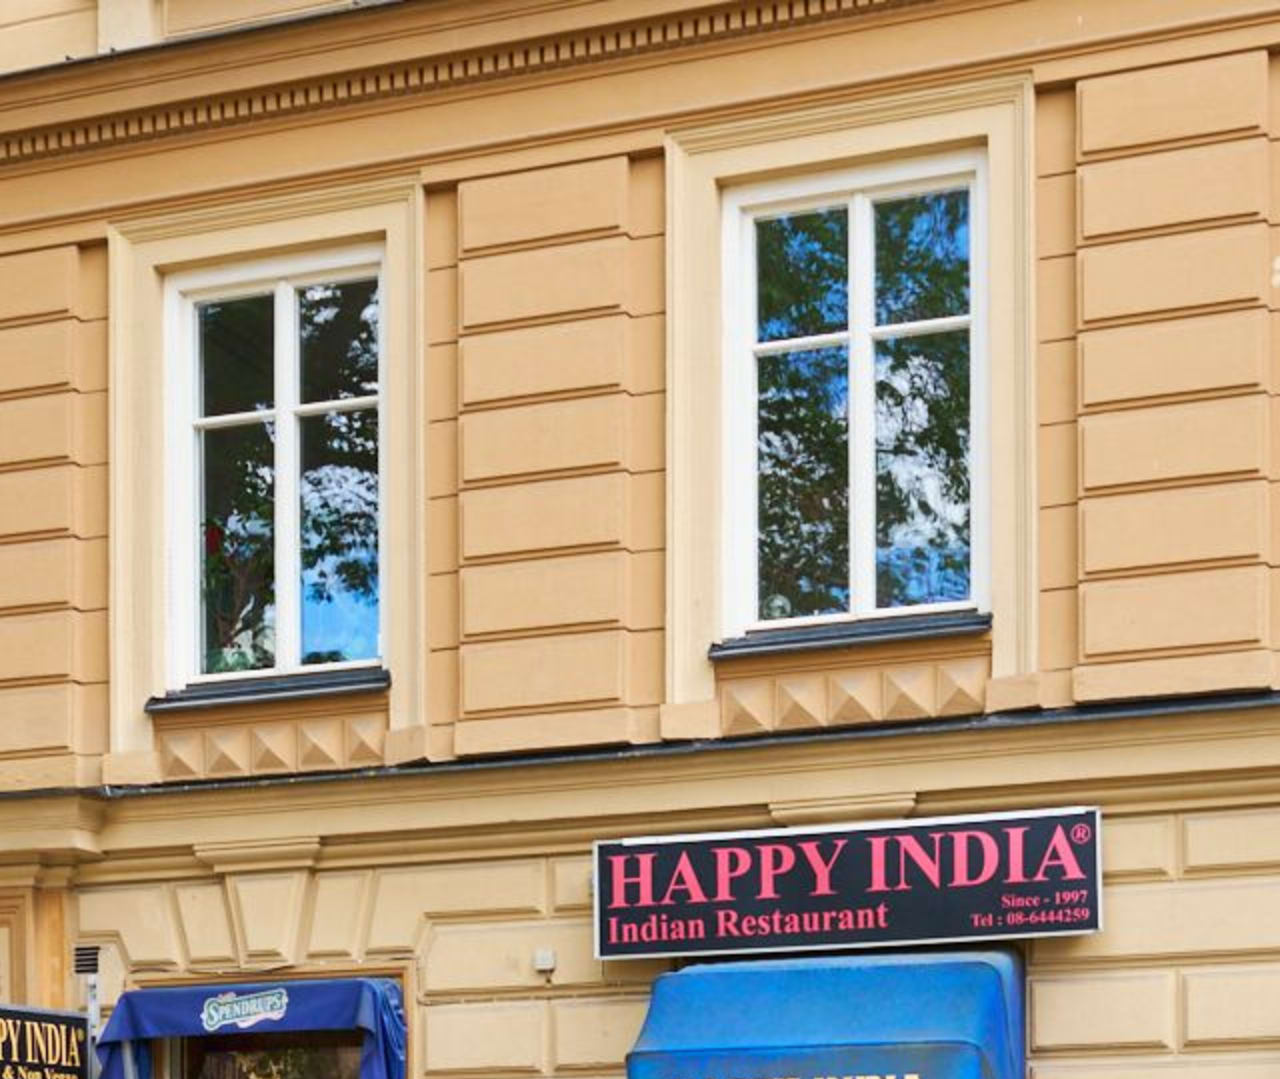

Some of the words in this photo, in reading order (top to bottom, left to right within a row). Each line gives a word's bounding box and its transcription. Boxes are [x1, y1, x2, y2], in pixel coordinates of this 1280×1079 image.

[607, 838, 849, 909] HAPPY
[1001, 894, 1040, 908] Since
[1055, 889, 1089, 905] 1997
[607, 913, 706, 944] Indian
[716, 901, 889, 938] Restaurant
